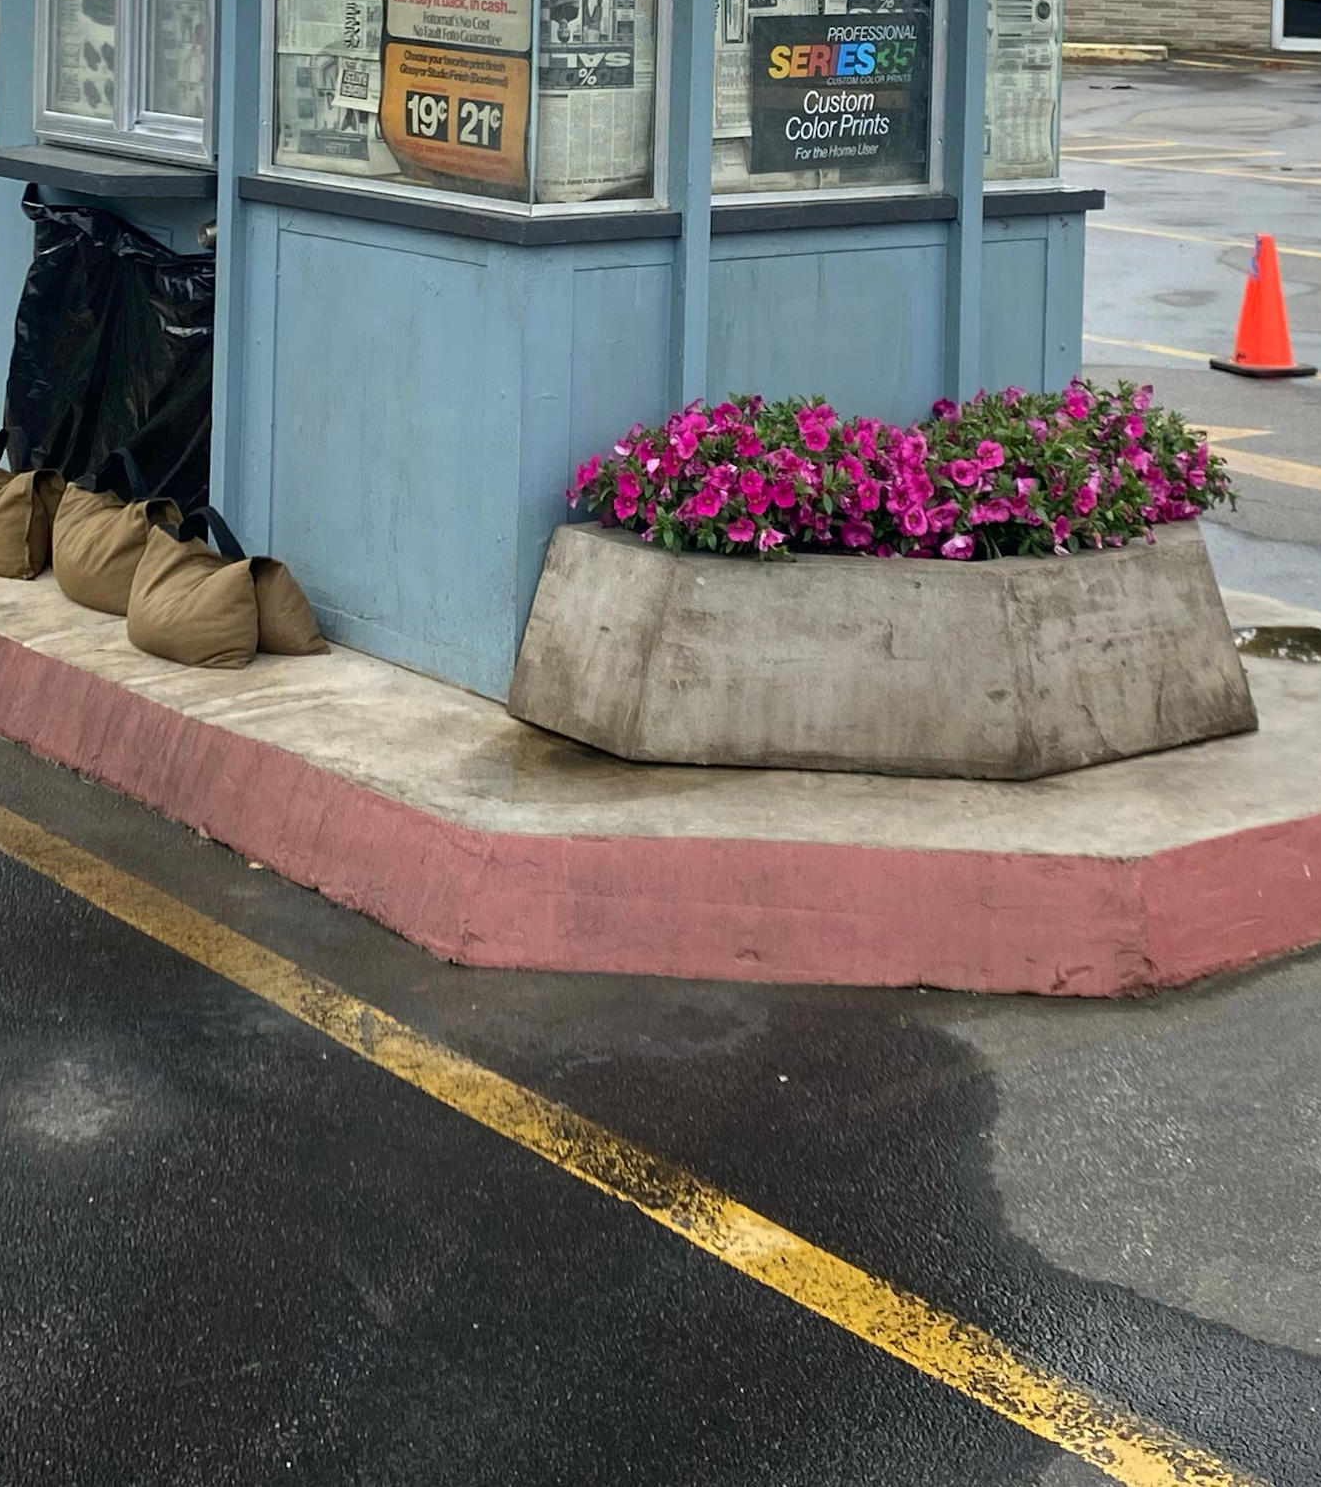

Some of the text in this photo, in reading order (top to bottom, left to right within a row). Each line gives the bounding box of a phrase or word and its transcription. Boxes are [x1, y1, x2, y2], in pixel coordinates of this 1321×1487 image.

[459, 14, 472, 27] No
[472, 16, 491, 31] Cost
[826, 24, 918, 42] PROFESSIONAL
[413, 24, 503, 47] No Fault Foto Guarantee
[768, 40, 918, 80] SERIES 35
[826, 73, 912, 87] CUSTOM COLOR PRINTS
[803, 89, 876, 115] Custom
[407, 94, 502, 146] 19¢ 21¢
[785, 112, 891, 141] Color Prints
[794, 143, 880, 161] For the Home User
